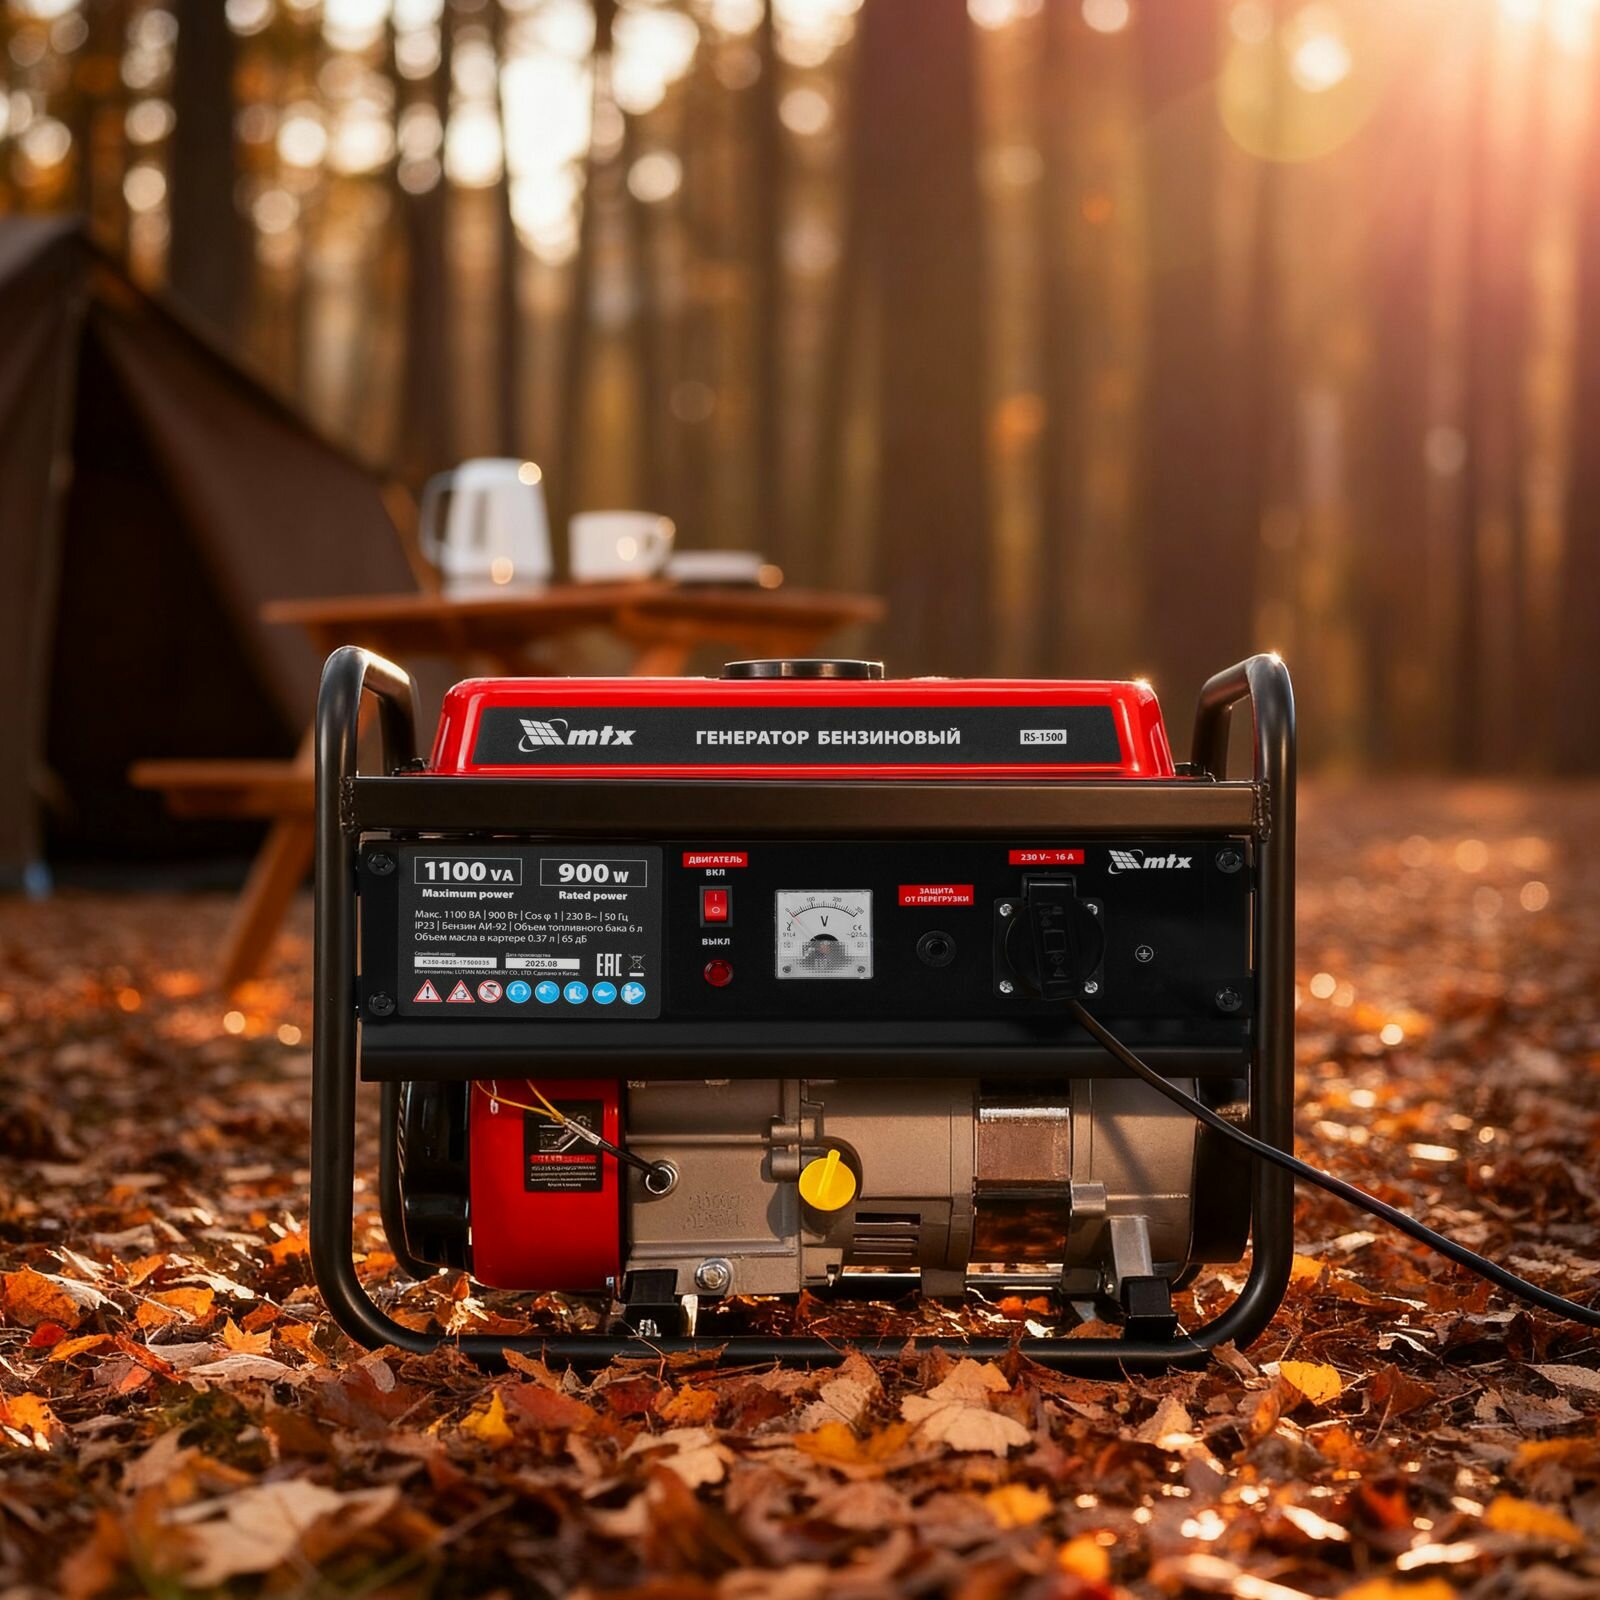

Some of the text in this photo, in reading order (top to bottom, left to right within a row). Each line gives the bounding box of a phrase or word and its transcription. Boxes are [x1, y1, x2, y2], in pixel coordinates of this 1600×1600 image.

[567, 725, 636, 746] mtx
[695, 728, 961, 745] ГЕНЕРАТОР БЕНЗИНОВЫЙ
[1022, 732, 1064, 742] RS-1500
[688, 856, 743, 864] ДВИГАТЕЛЬ
[1143, 856, 1193, 868] mtx
[424, 861, 514, 881] 1100 VA
[559, 863, 609, 883] 900
[705, 869, 725, 877] ВКЛ
[422, 889, 514, 900] Maximum power
[559, 891, 627, 901] Rated power
[919, 887, 954, 895] ЗАЩИТА
[904, 895, 969, 903] ОТ ПЕРЕГРУЗКИ
[414, 910, 442, 920] Макс.
[444, 910, 467, 920] 1100
[469, 910, 481, 921] ВА
[488, 911, 505, 921] 900
[507, 911, 518, 921] Вт
[524, 911, 542, 921] Cos
[554, 911, 558, 921] 1
[566, 911, 583, 922] 230
[604, 912, 616, 922] 50
[618, 912, 629, 922] Гц
[820, 915, 828, 927] V
[414, 921, 435, 931] IP23
[442, 922, 477, 931] Бензин
[478, 922, 507, 932] АИ-92
[514, 922, 546, 932] Объем
[548, 924, 603, 933] топливного
[605, 923, 628, 933] бака
[629, 923, 635, 933] 6
[636, 925, 643, 933] л
[414, 933, 447, 943] Объем
[449, 935, 478, 943] масла
[479, 935, 486, 943] в
[488, 935, 526, 944] картере
[528, 934, 547, 944] 0.37
[562, 934, 573, 944] 65
[575, 934, 587, 944] дБ
[702, 938, 731, 946] ВЫКЛ
